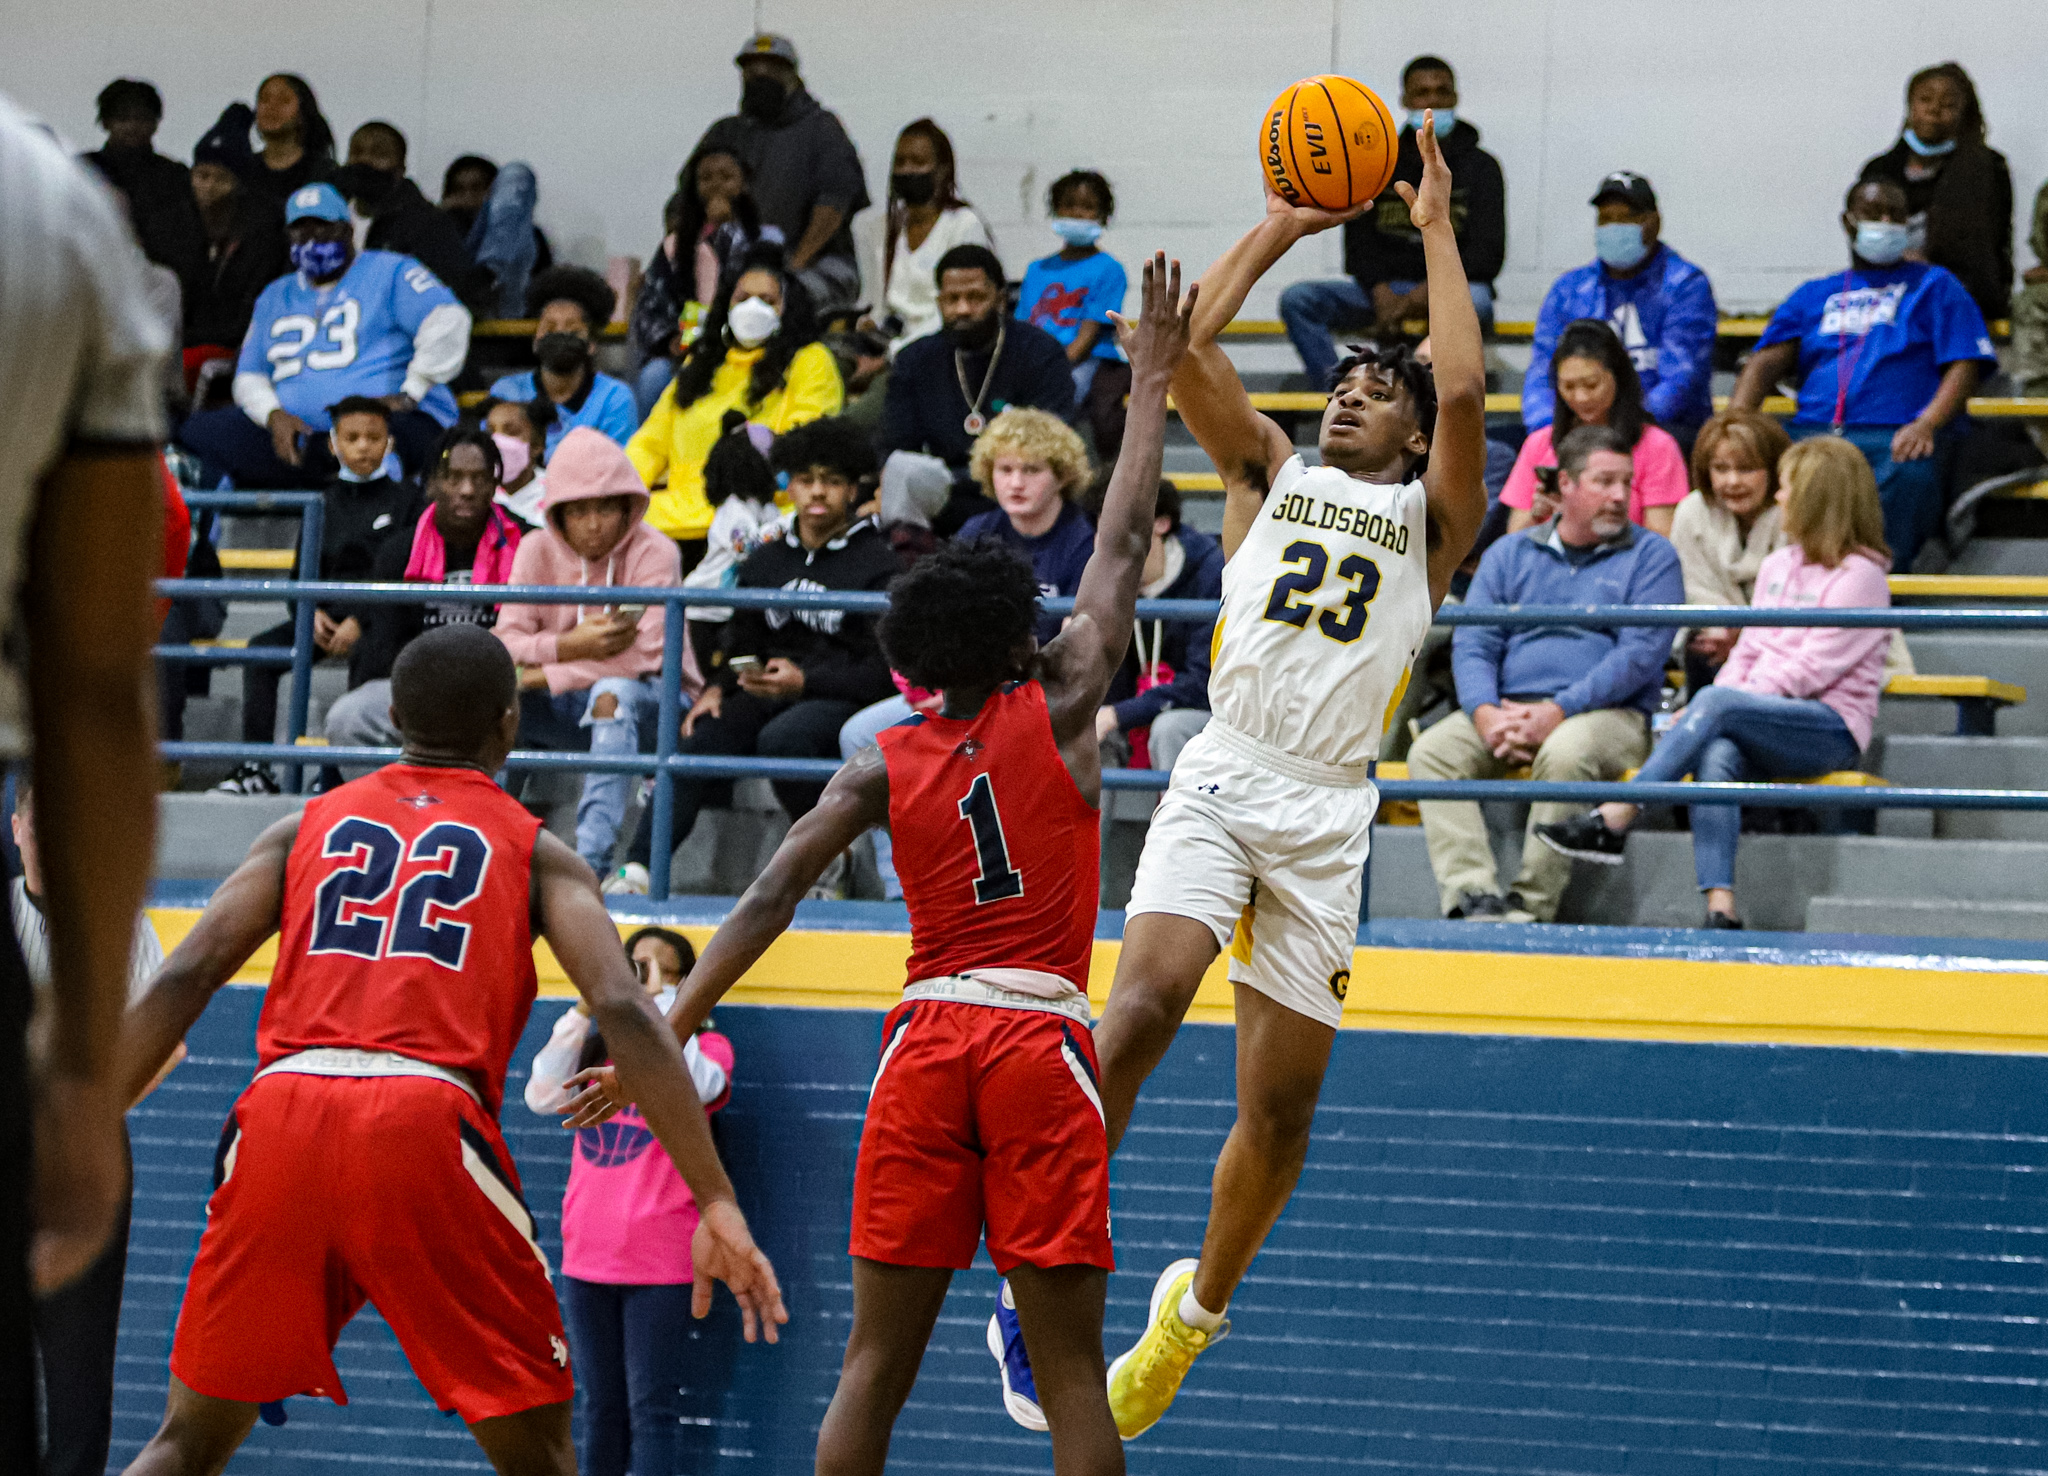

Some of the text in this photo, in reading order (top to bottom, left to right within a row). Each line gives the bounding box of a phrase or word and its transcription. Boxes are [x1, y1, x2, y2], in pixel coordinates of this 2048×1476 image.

[1267, 110, 1300, 203] Wilson
[267, 299, 360, 381] 23
[1262, 539, 1383, 645] 23
[957, 771, 1024, 905] 1
[307, 815, 493, 971] 22
